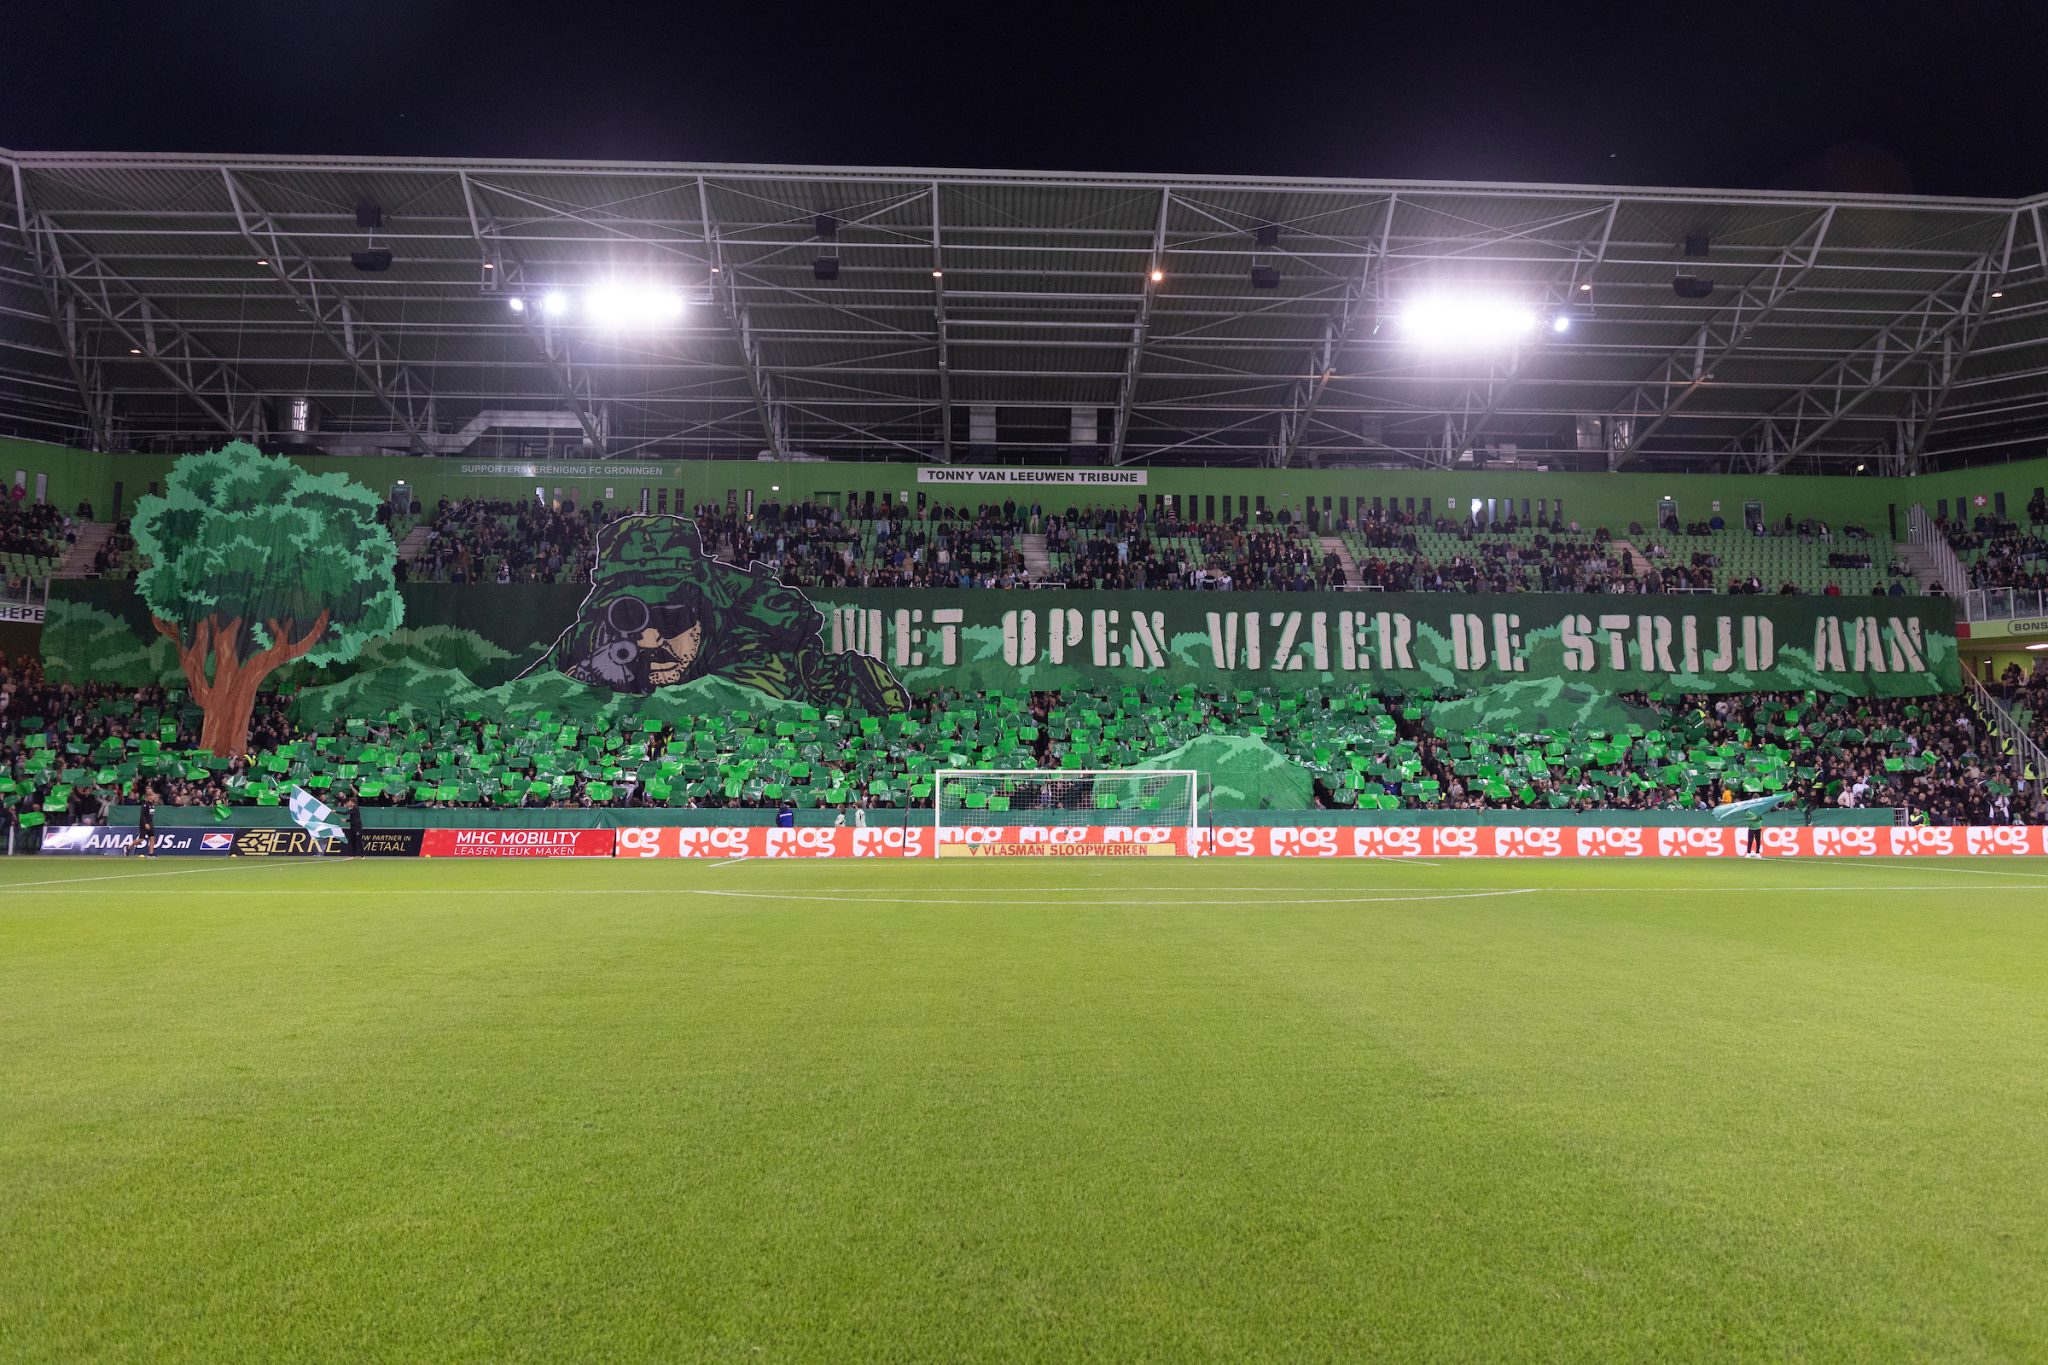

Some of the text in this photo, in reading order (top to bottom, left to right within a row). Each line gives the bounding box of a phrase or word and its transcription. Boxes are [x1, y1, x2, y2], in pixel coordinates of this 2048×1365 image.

[461, 464, 663, 476] SUPPORTERSVERENIGING FC GRONINGEN
[927, 470, 1138, 483] TONNY VAN LEEUWEN TRIBUNE
[832, 608, 1926, 673] MET OPEN VIZIER DE STRIJD AAN
[371, 834, 402, 842] PARTNER
[456, 831, 581, 845] MHC MOBILITY
[454, 846, 575, 856] LEASEN LEUK MAKEN
[983, 844, 1148, 856] VLASMAN SLOOPWERKEN
